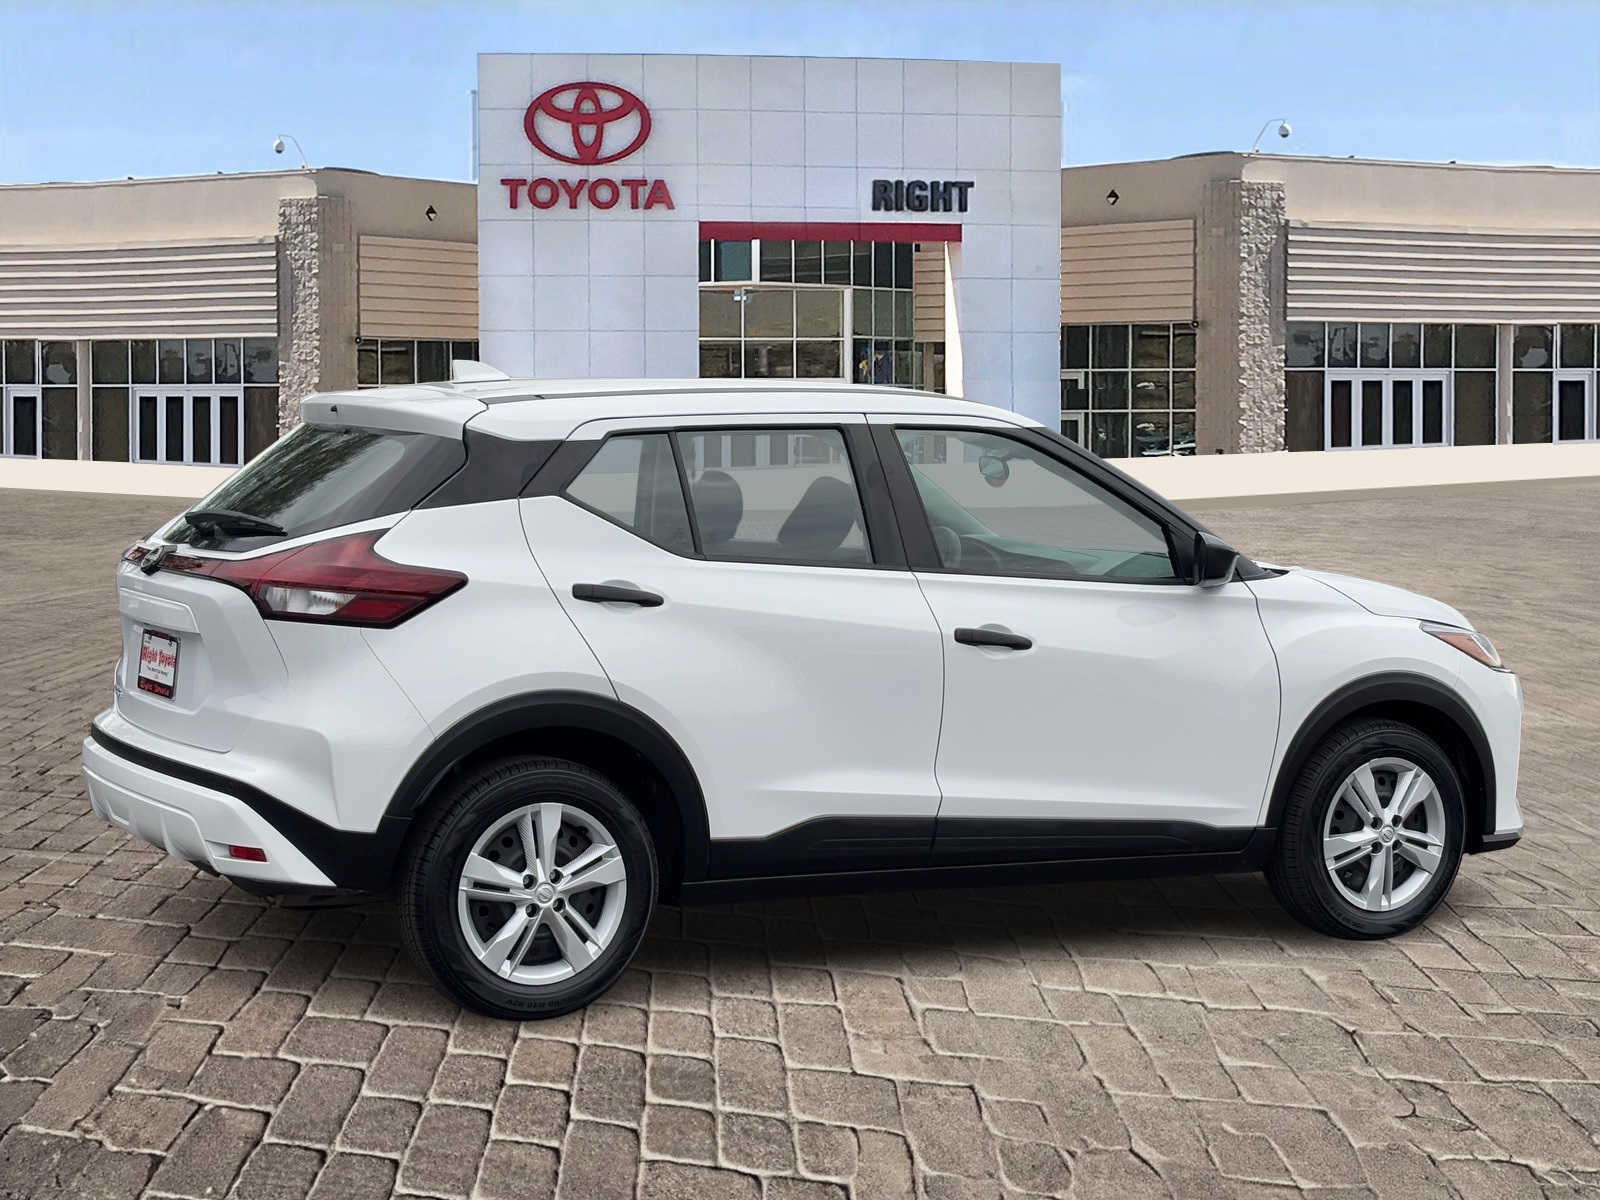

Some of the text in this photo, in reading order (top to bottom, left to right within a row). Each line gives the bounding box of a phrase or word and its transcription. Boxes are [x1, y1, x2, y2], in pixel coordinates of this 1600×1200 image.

[500, 178, 675, 210] TOYOTA
[872, 180, 975, 213] RIGHT
[142, 646, 176, 668] Right Toyota
